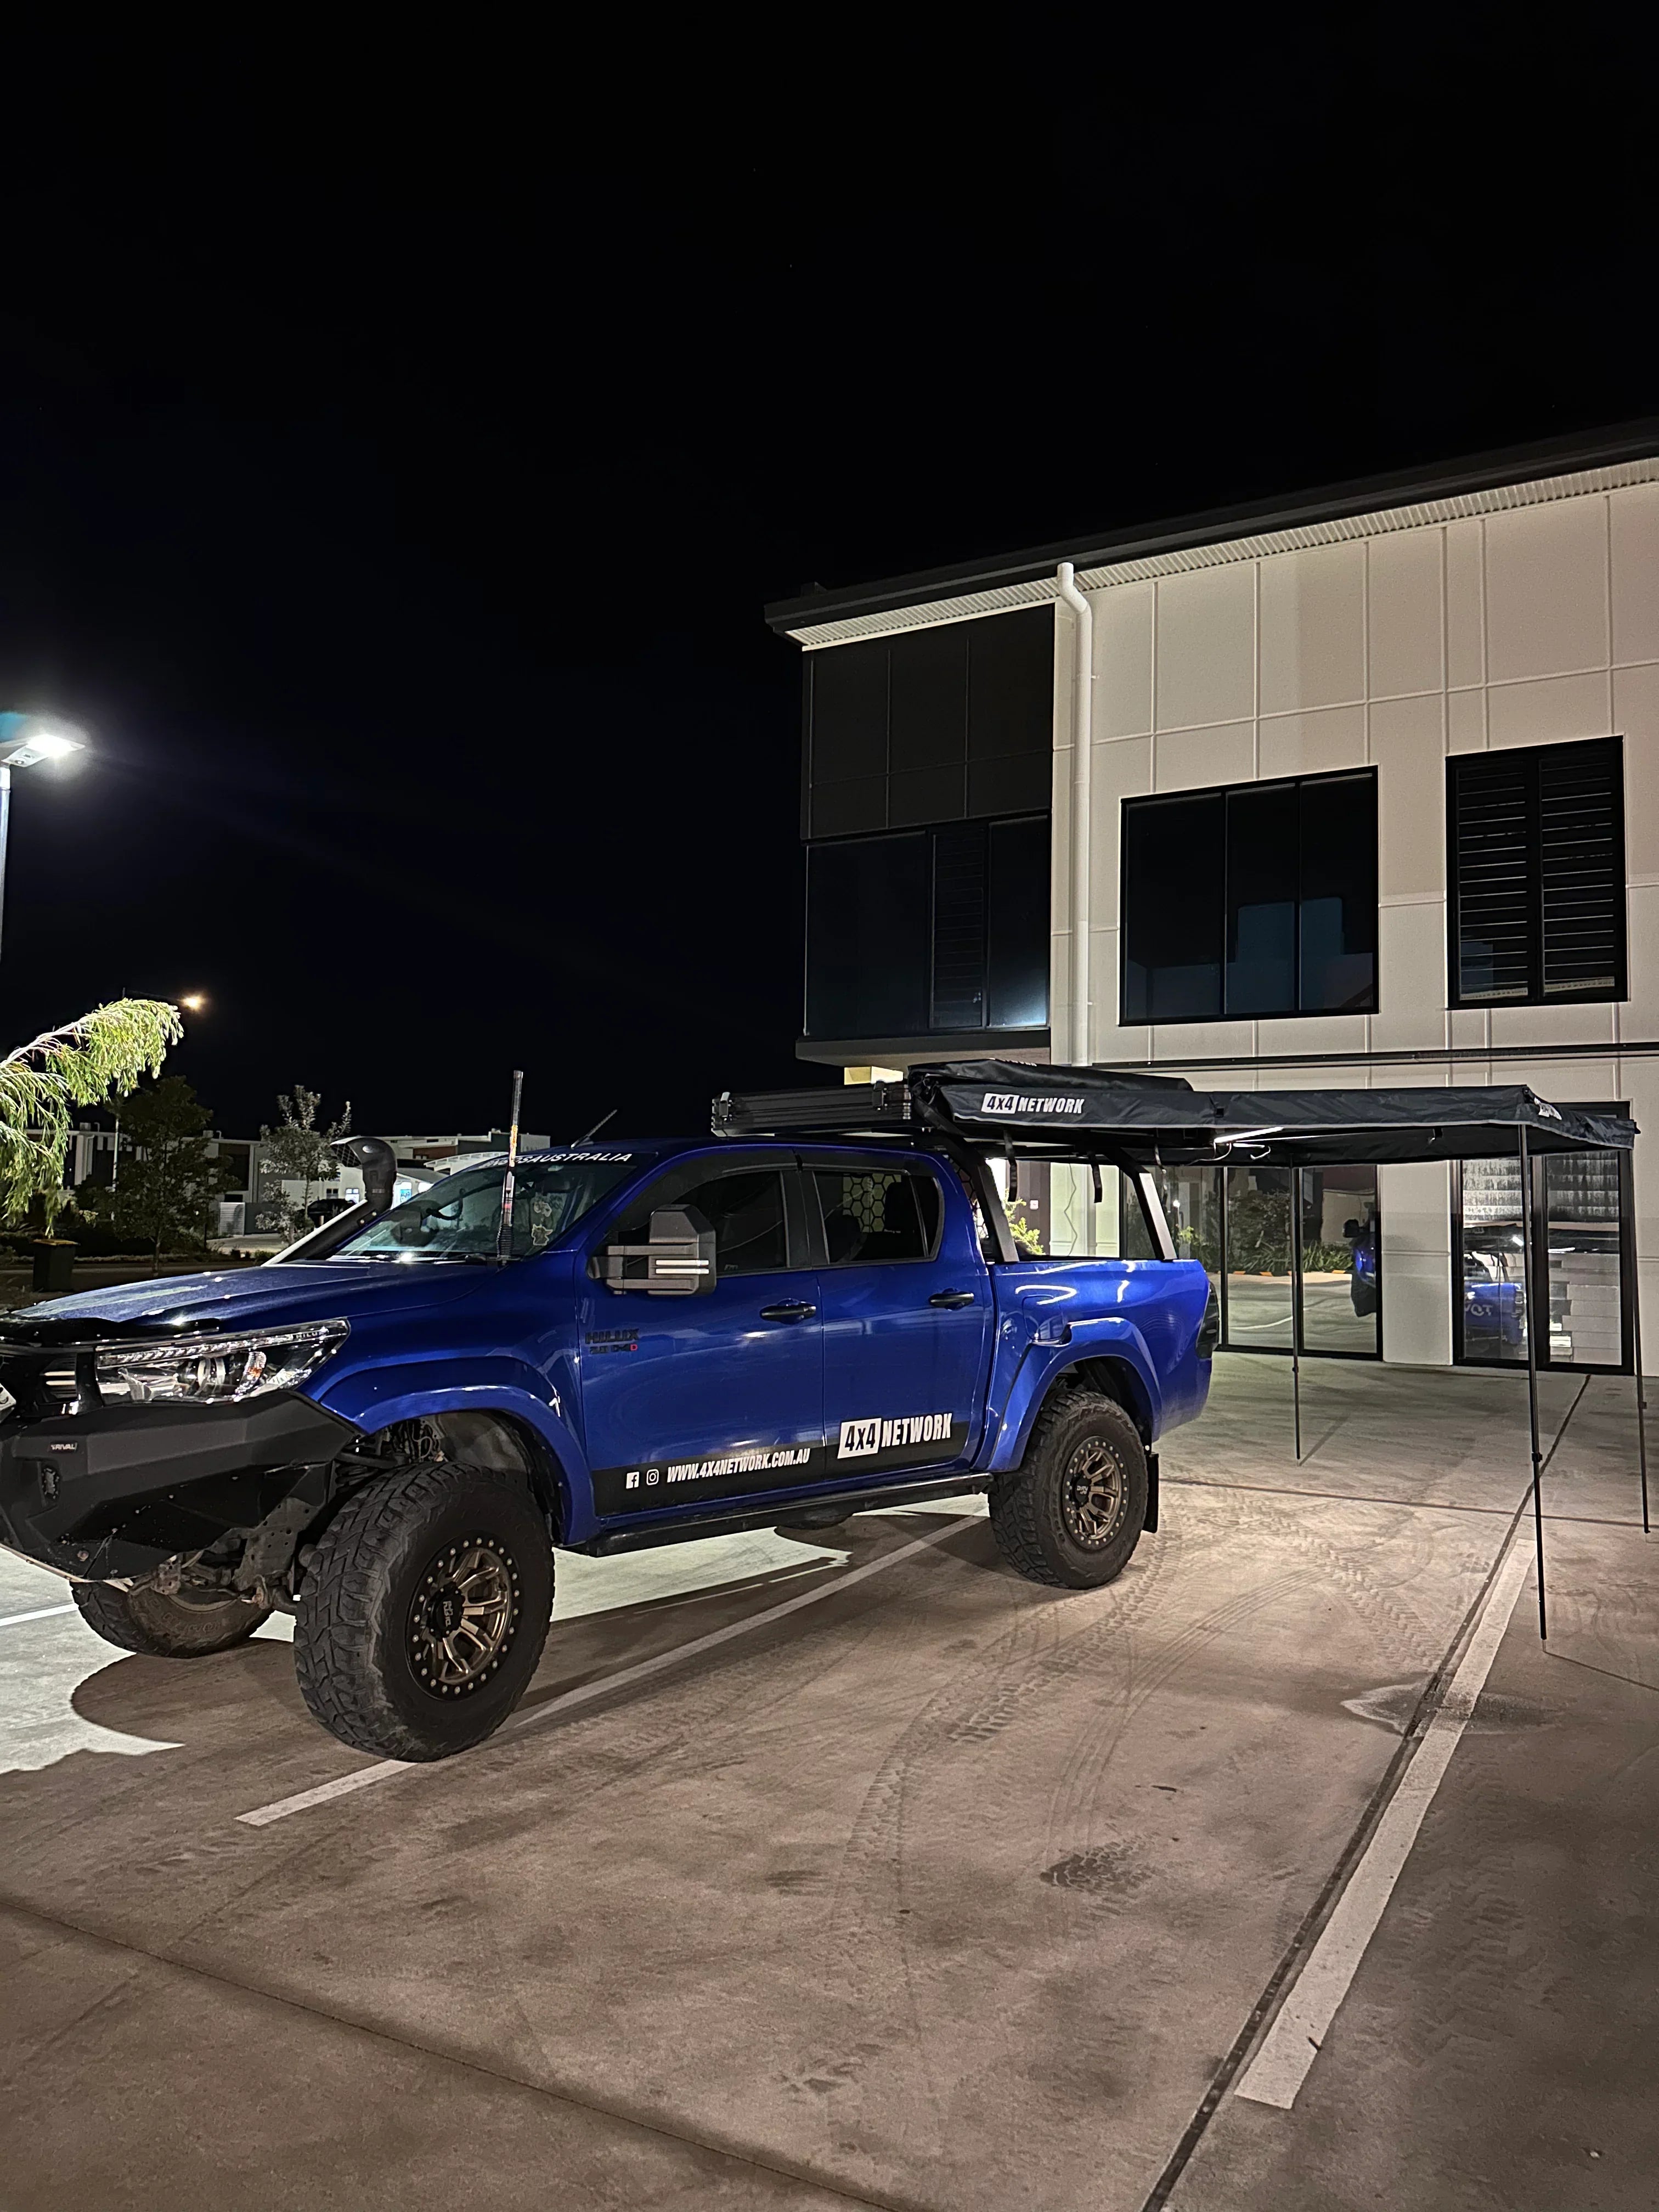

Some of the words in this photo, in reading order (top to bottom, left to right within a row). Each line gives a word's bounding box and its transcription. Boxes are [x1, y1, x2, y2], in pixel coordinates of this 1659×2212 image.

[1018, 1097, 1085, 1114] NETWORK
[881, 1413, 952, 1447] NETWORK
[667, 1448, 811, 1483] WWW.4X4NETWORK.COM.AU
